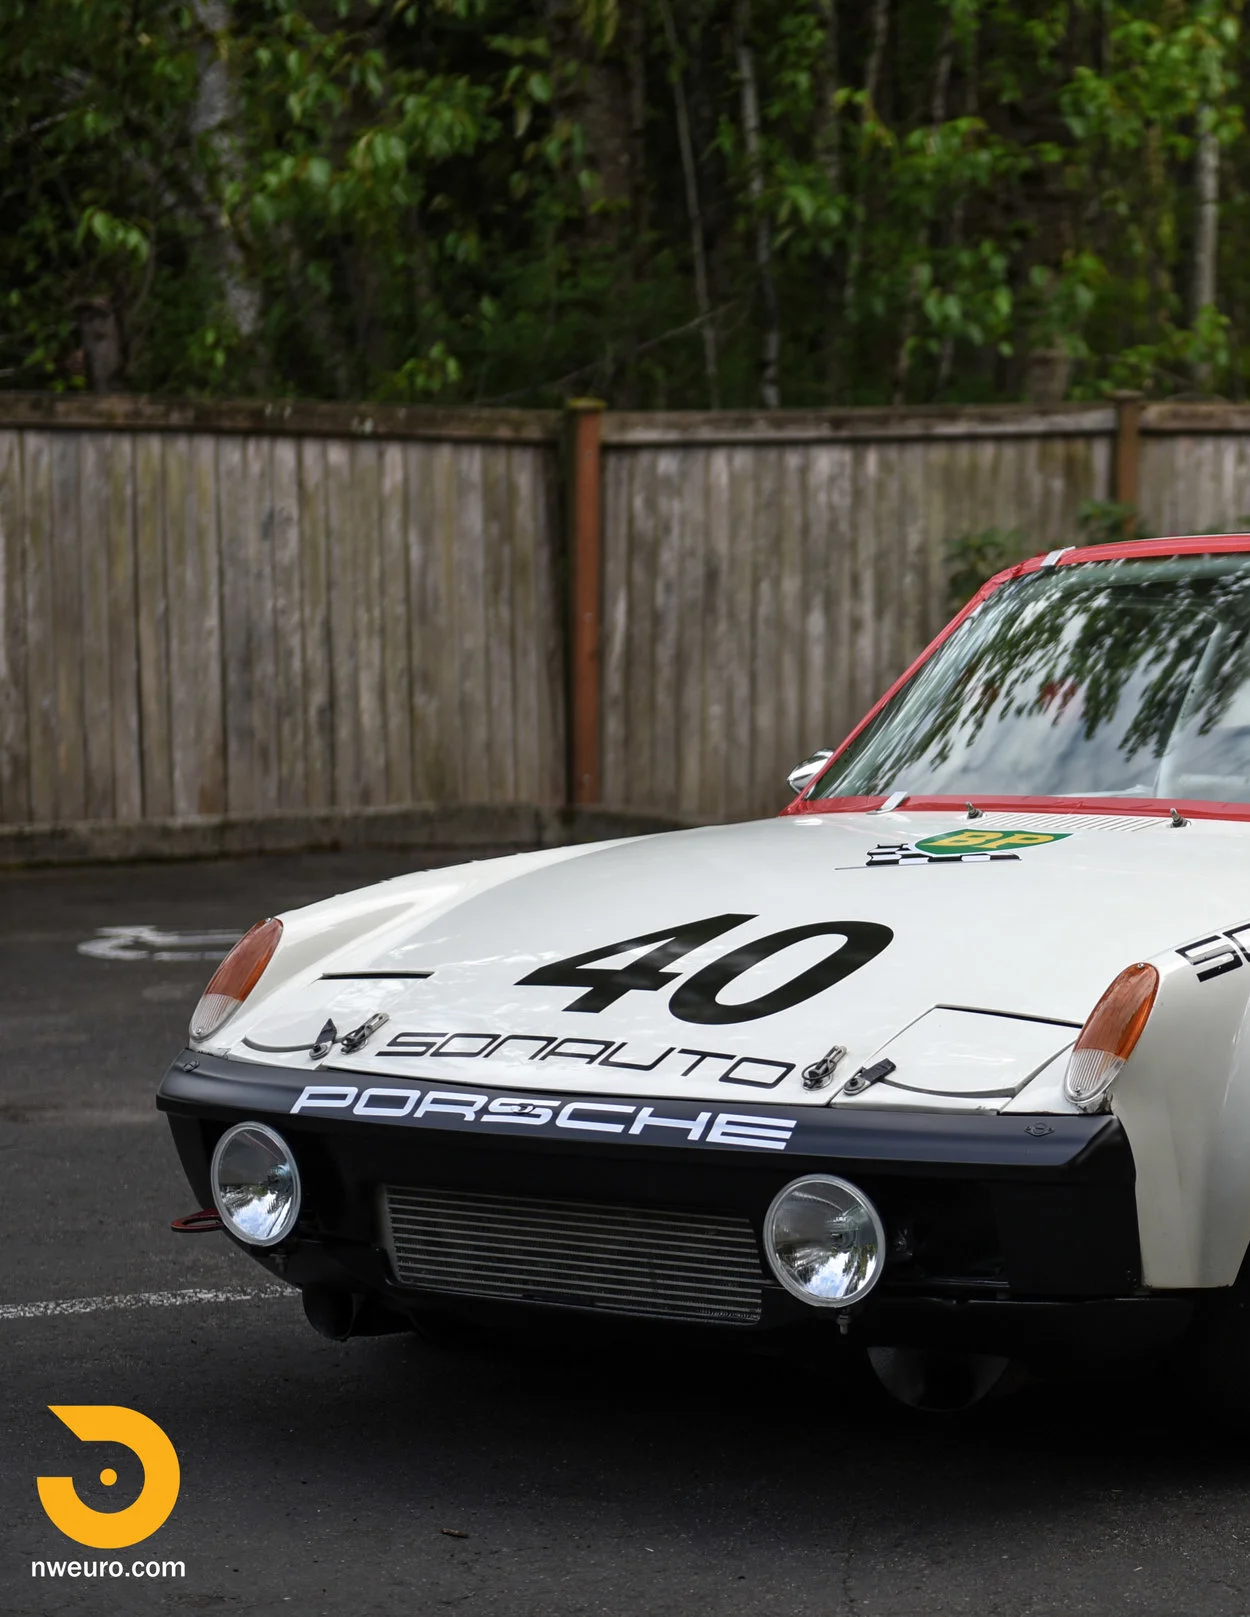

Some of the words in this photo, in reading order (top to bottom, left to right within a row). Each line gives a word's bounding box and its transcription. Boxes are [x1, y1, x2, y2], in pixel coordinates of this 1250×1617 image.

[920, 831, 1055, 849] BP
[514, 913, 894, 1025] 40
[375, 1032, 796, 1089] SONAUTO
[290, 1086, 797, 1150] PORSCHE
